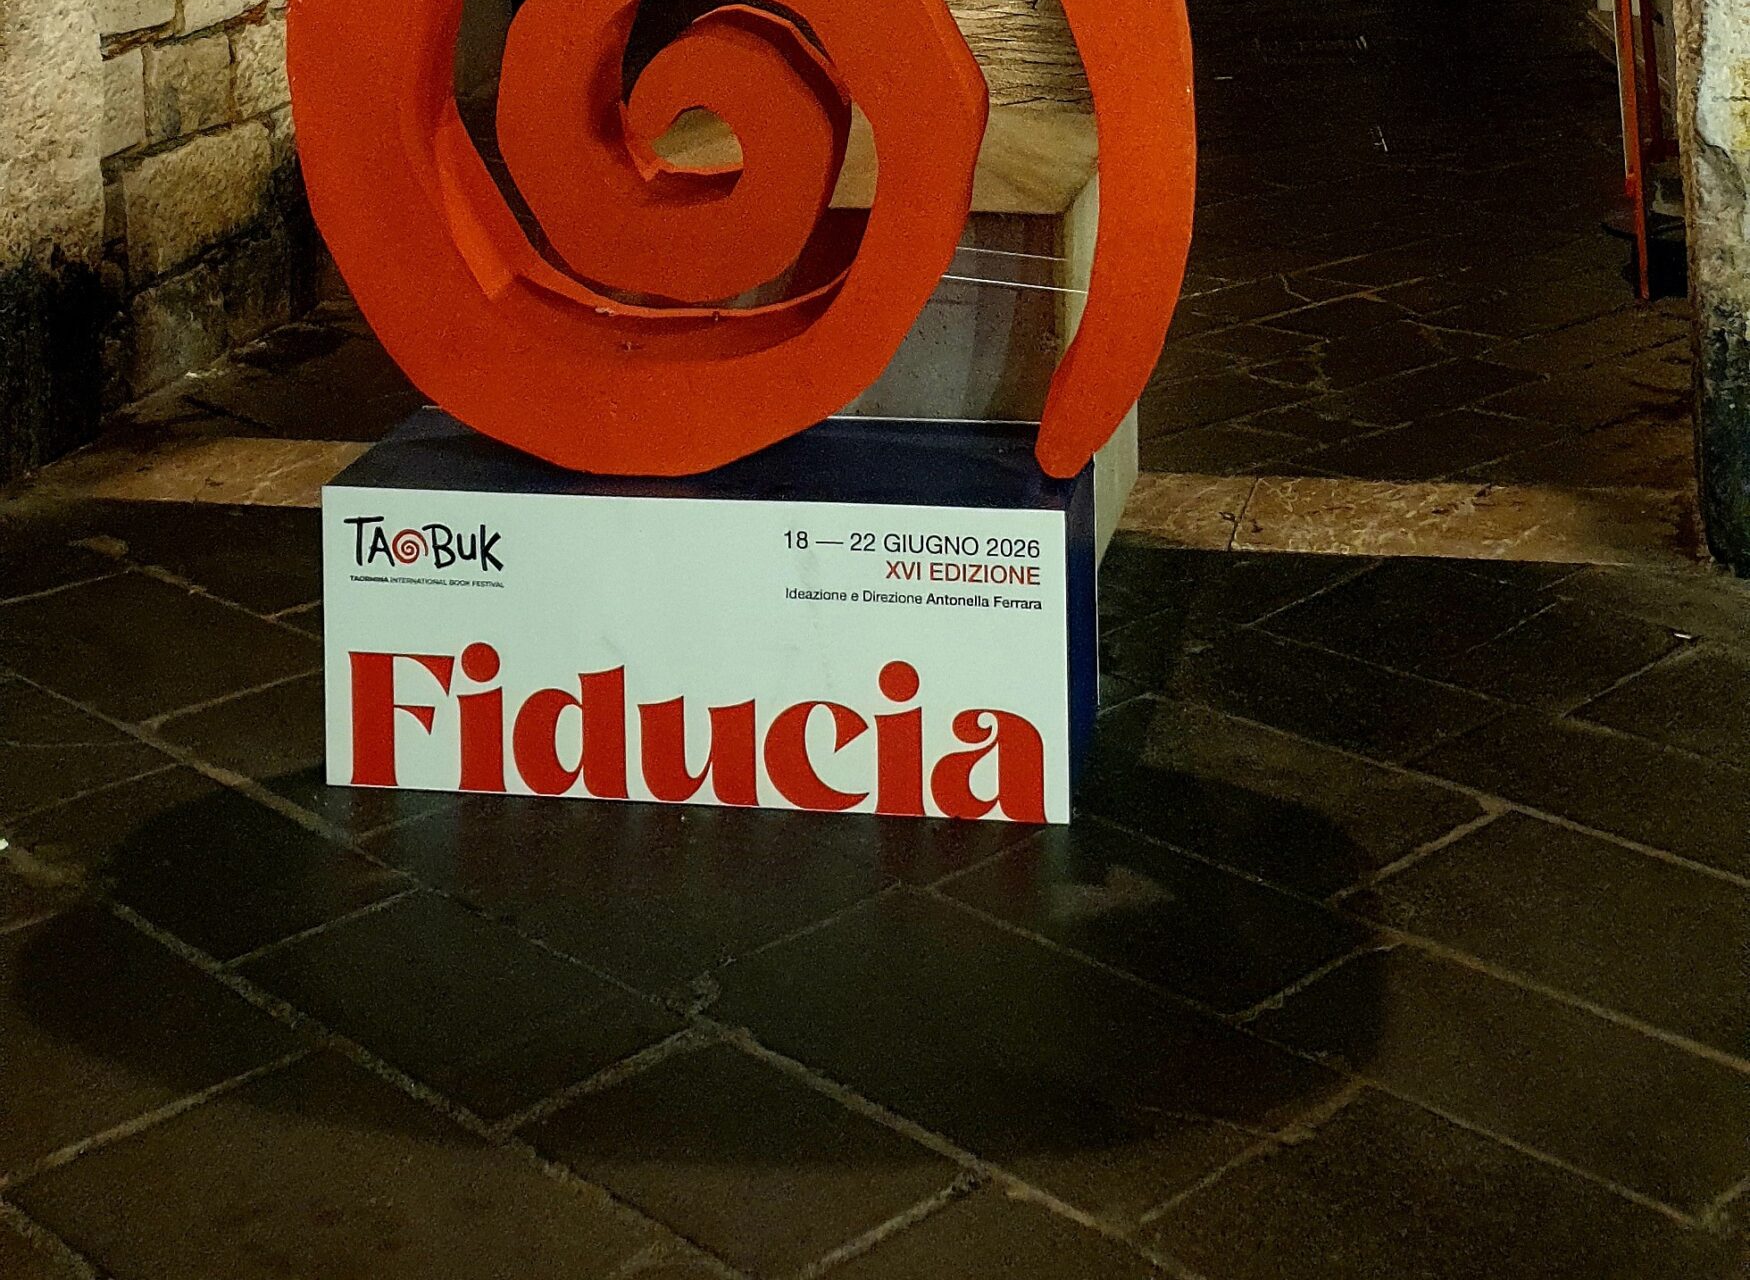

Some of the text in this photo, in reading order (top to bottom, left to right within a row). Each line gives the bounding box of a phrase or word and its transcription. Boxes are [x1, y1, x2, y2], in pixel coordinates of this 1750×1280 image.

[784, 530, 808, 549] 18
[850, 533, 875, 552] 22
[884, 533, 979, 556] GIUGNO
[986, 538, 1040, 558] 2026
[350, 575, 389, 583] TAORMINA
[390, 577, 447, 585] INTERNATIONAL
[886, 560, 1040, 585] XVI EDIZIONE
[786, 588, 1042, 610] Ideazione e Direzione Antonella Ferrara
[348, 642, 1048, 823] Fiducia
